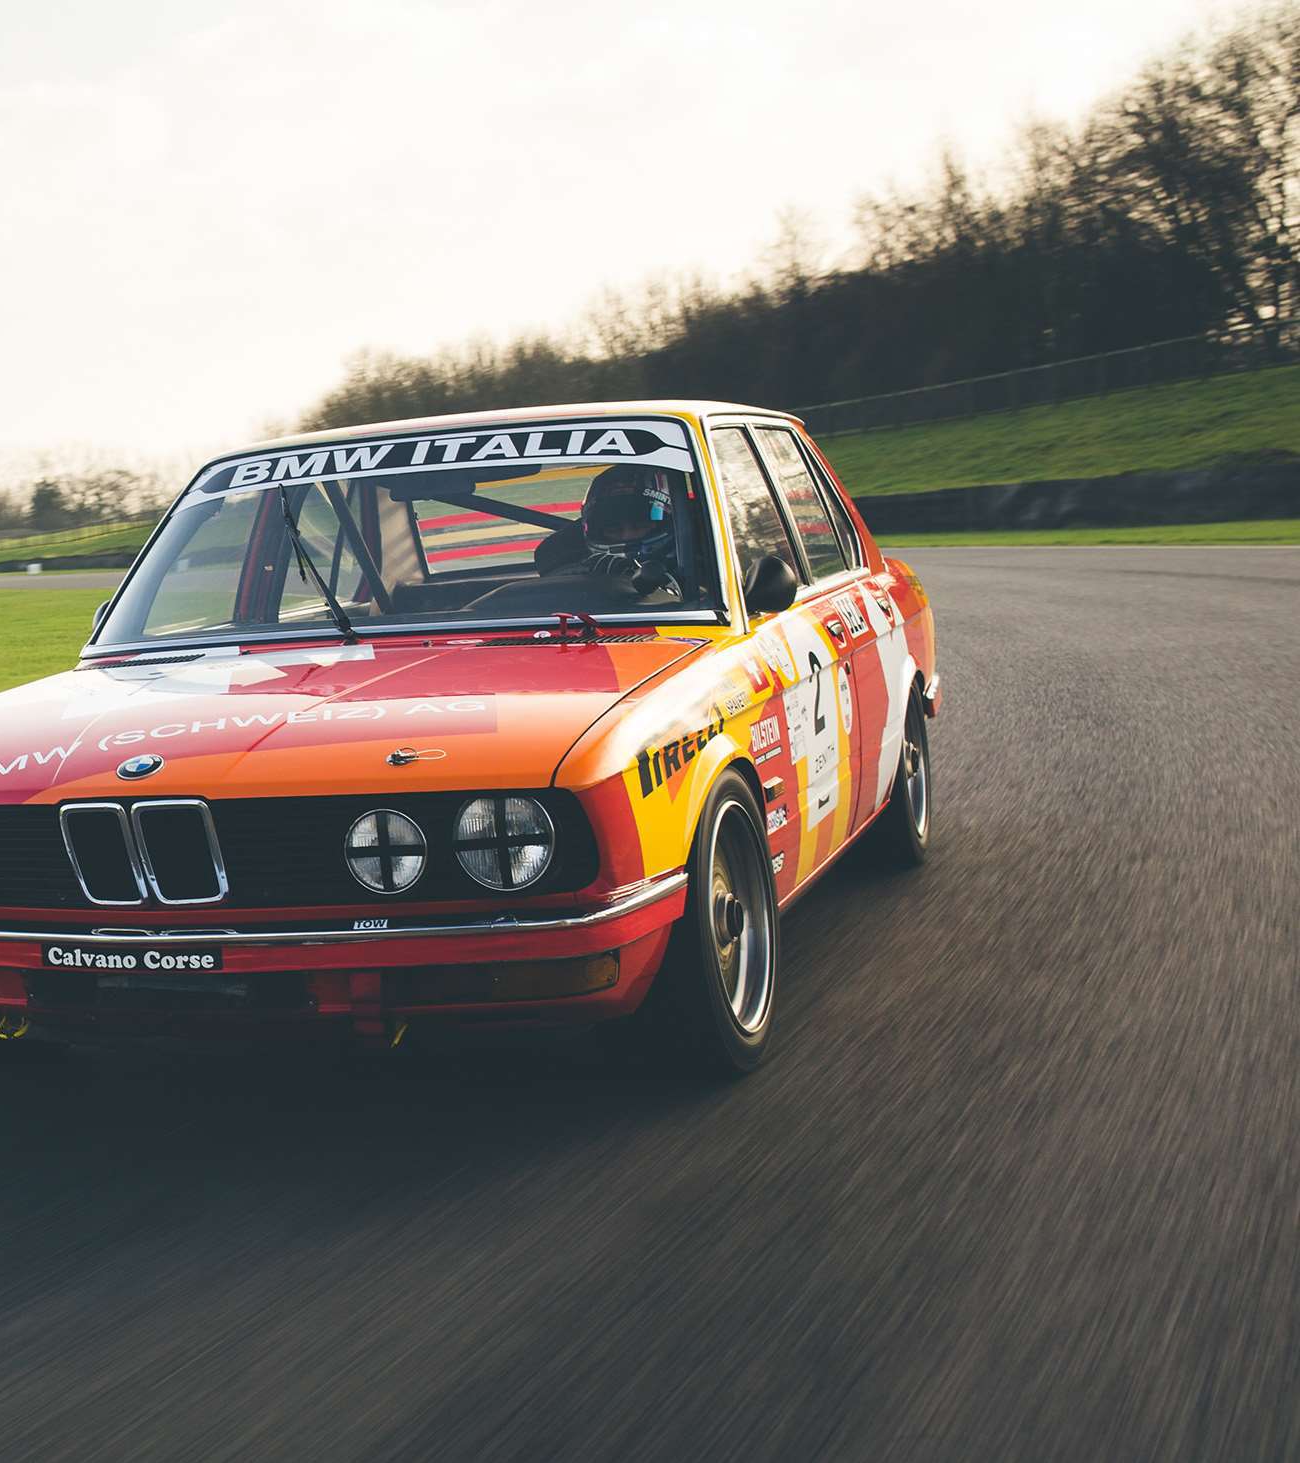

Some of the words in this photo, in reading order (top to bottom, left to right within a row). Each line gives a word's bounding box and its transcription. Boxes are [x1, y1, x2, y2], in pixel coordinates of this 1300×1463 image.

[228, 444, 395, 488] BMW
[410, 429, 637, 465] ITALIA
[808, 651, 826, 736] 2
[98, 705, 387, 751] (SCHWEIZ)
[404, 701, 486, 715] AG
[750, 715, 780, 752] BILSTEIN
[814, 742, 835, 773] ZEN
[354, 919, 387, 929] TOW
[48, 947, 137, 969] Calvano
[143, 950, 215, 969] Corse
